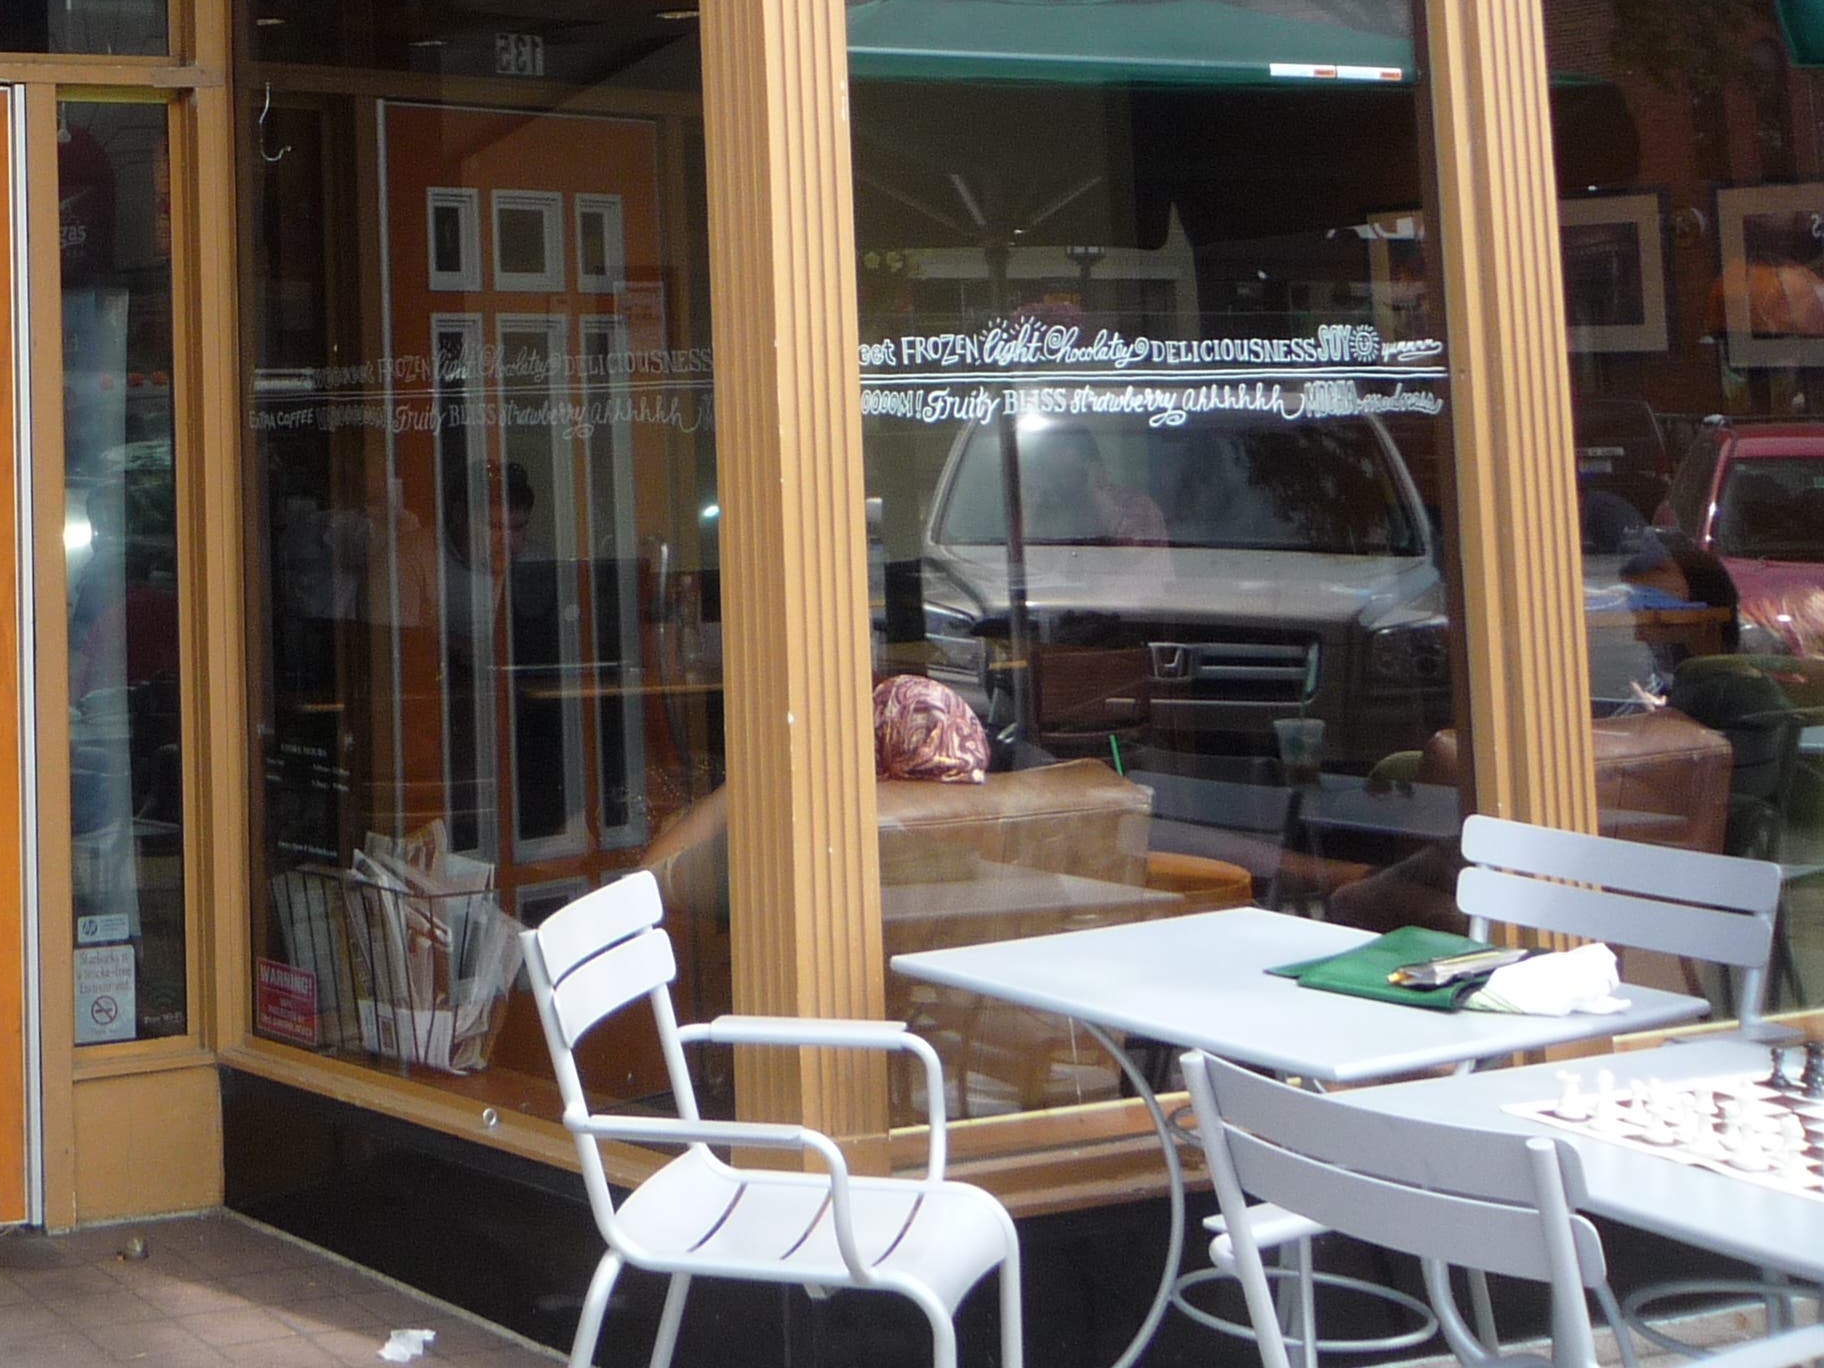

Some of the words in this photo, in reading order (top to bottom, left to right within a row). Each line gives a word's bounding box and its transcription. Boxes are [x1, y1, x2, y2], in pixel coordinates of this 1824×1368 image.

[901, 334, 979, 367] FROZEN
[1151, 337, 1317, 364] DELICIOUSNESS
[923, 386, 1001, 425] Fruity
[1002, 389, 1067, 416] BLISS
[1070, 384, 1187, 427] strawberry
